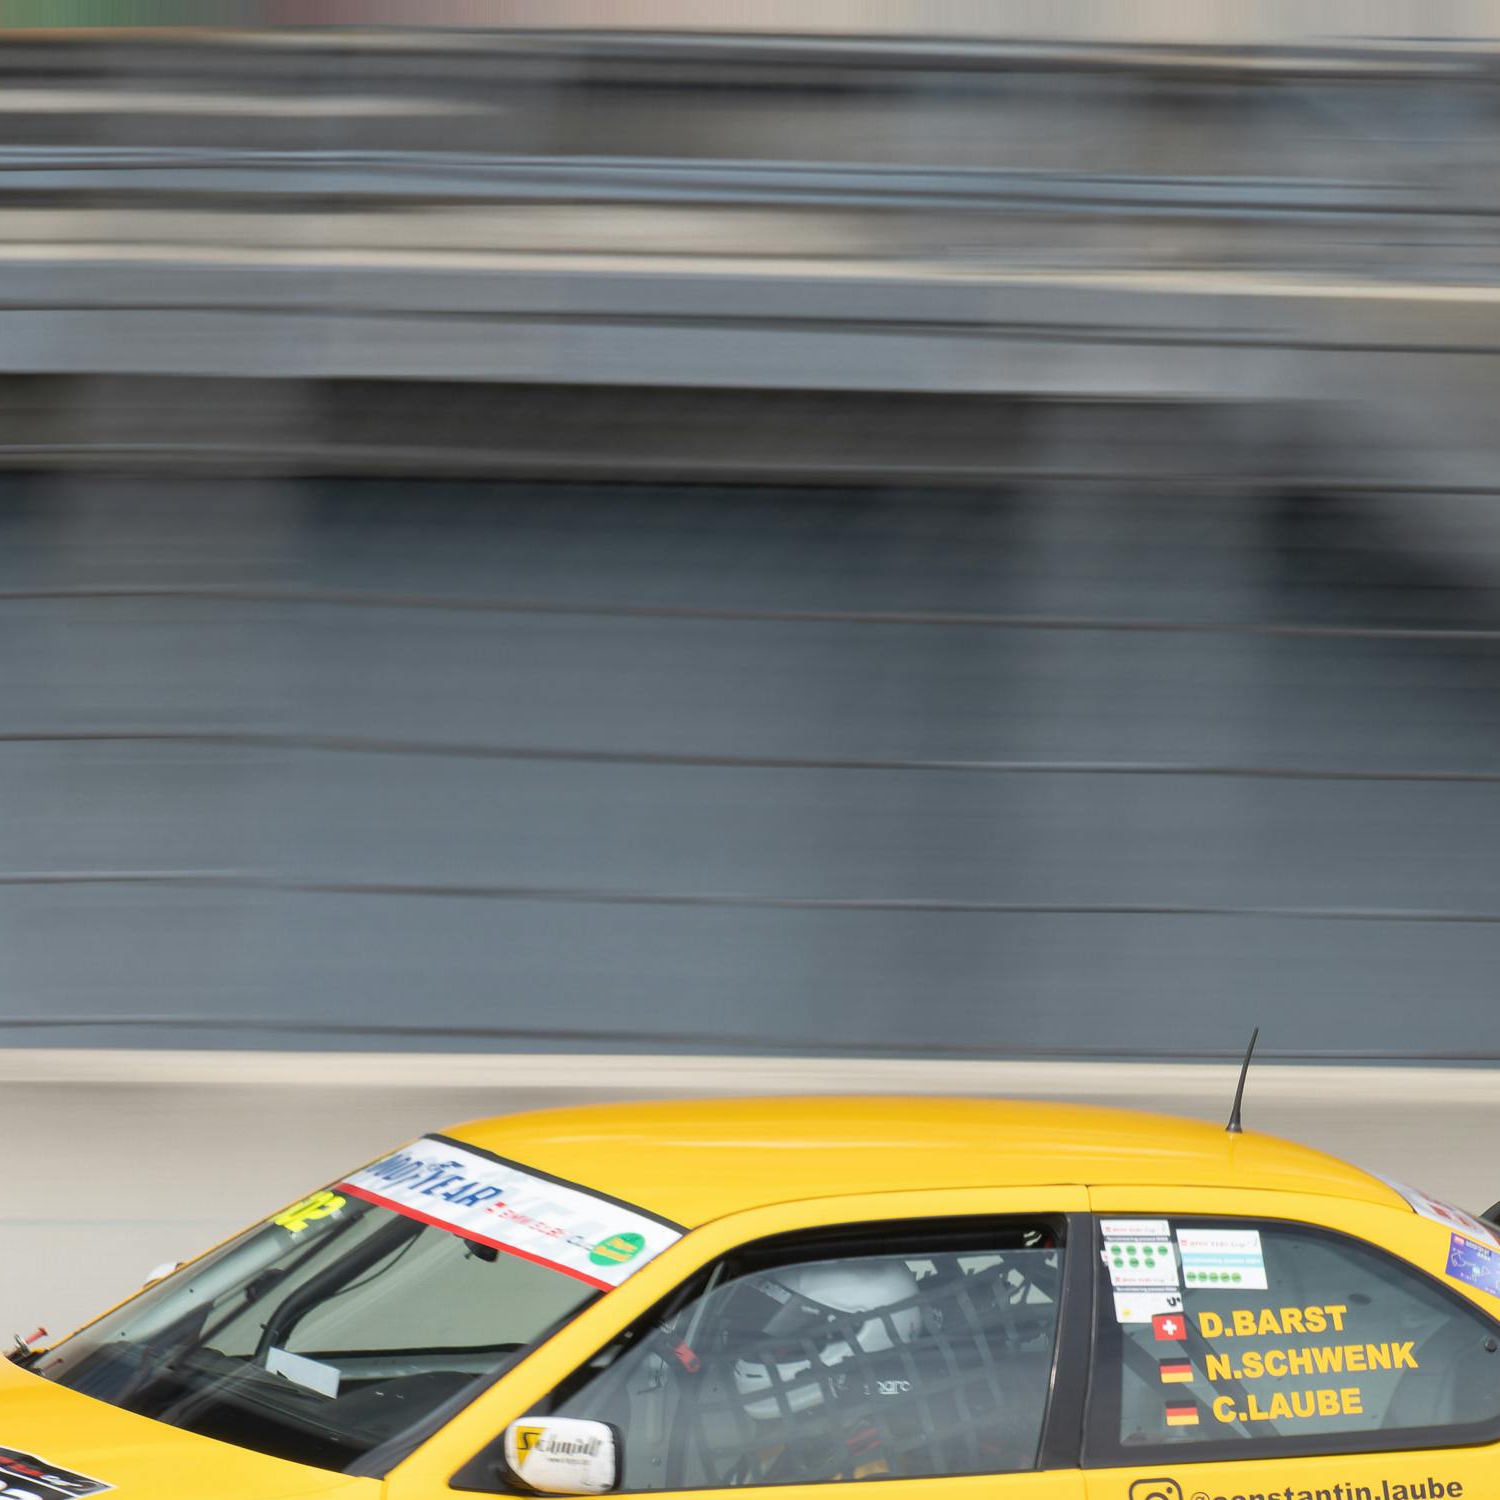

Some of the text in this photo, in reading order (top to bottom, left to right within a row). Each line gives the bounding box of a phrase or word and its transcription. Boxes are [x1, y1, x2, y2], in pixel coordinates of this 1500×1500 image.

[1198, 1305, 1347, 1338] D.BARST
[1205, 1341, 1419, 1381] N.SCHWENK
[1212, 1387, 1364, 1423] C.LAUBE
